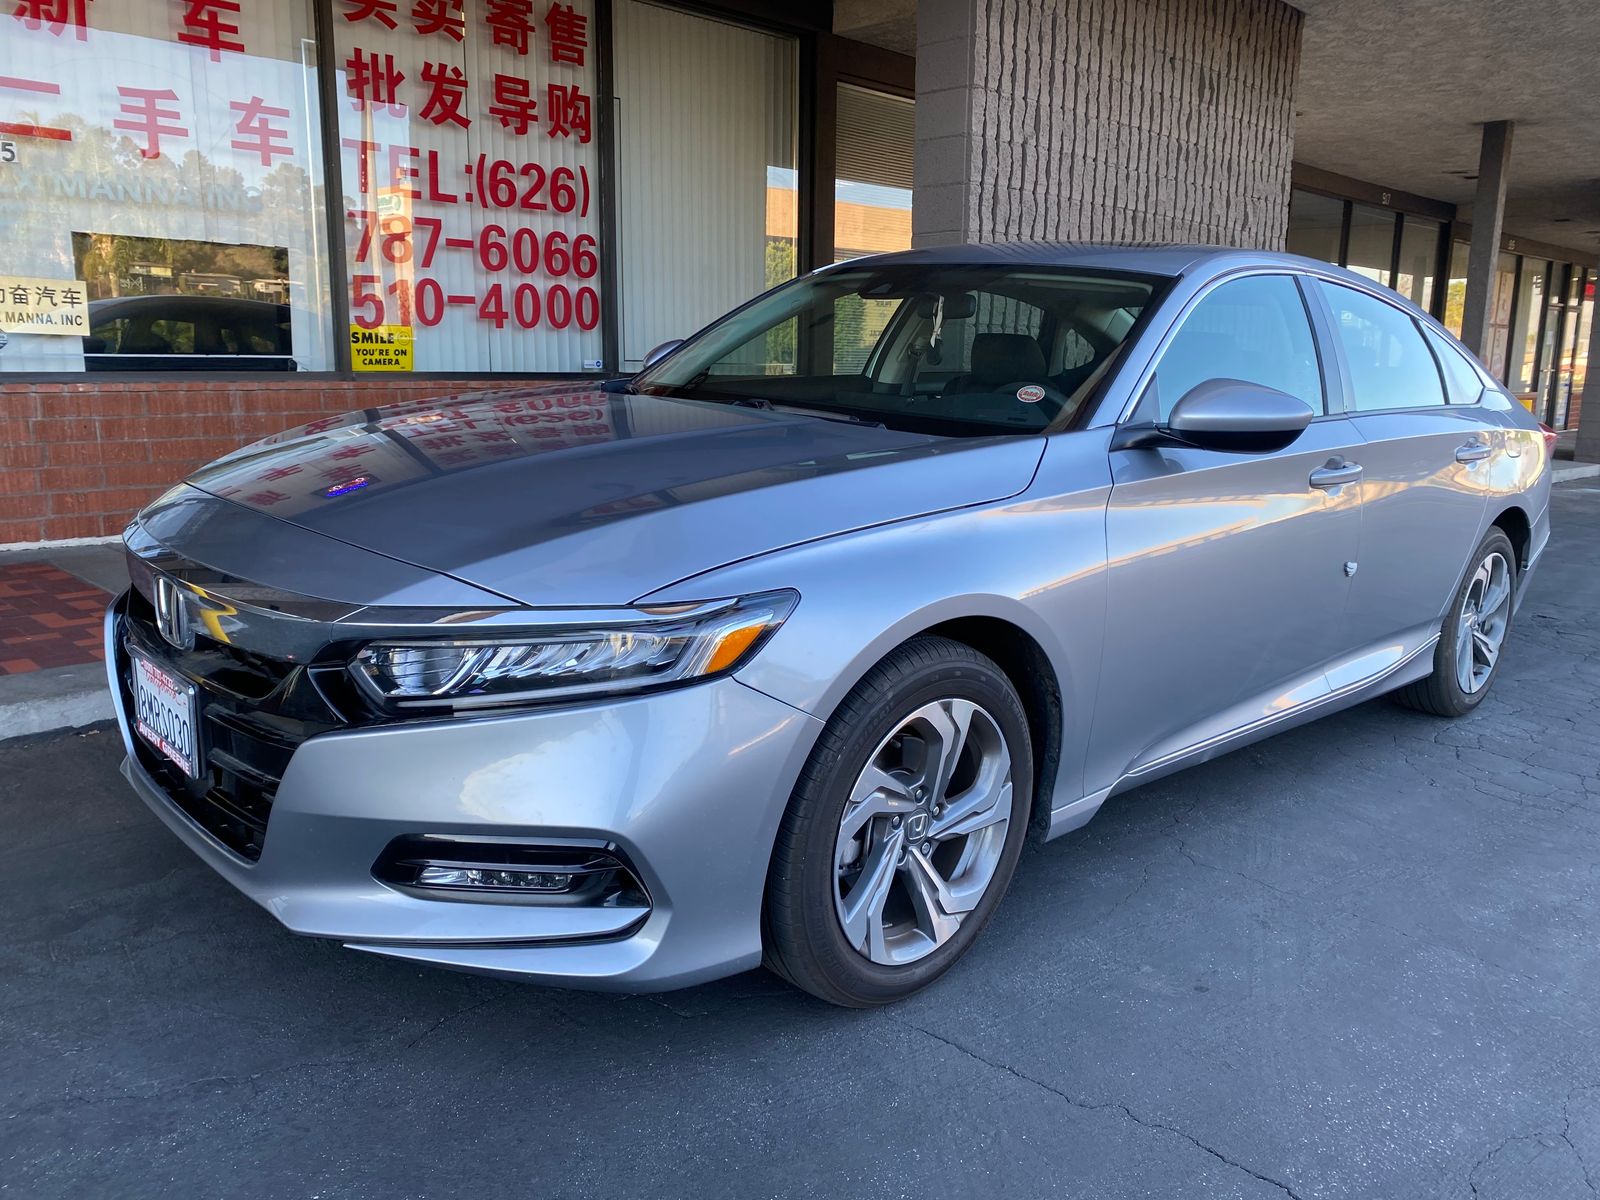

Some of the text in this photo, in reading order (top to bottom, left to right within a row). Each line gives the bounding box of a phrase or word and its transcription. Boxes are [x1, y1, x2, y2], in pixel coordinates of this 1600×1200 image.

[53, 169, 194, 204] MANNA
[207, 182, 264, 212] INC
[347, 210, 598, 280] 787-6066
[61, 314, 83, 326] INC
[352, 274, 600, 330] 510-4000
[352, 332, 395, 344] SMILE
[362, 358, 401, 366] CAMERA
[140, 685, 191, 761] 8MRS030
